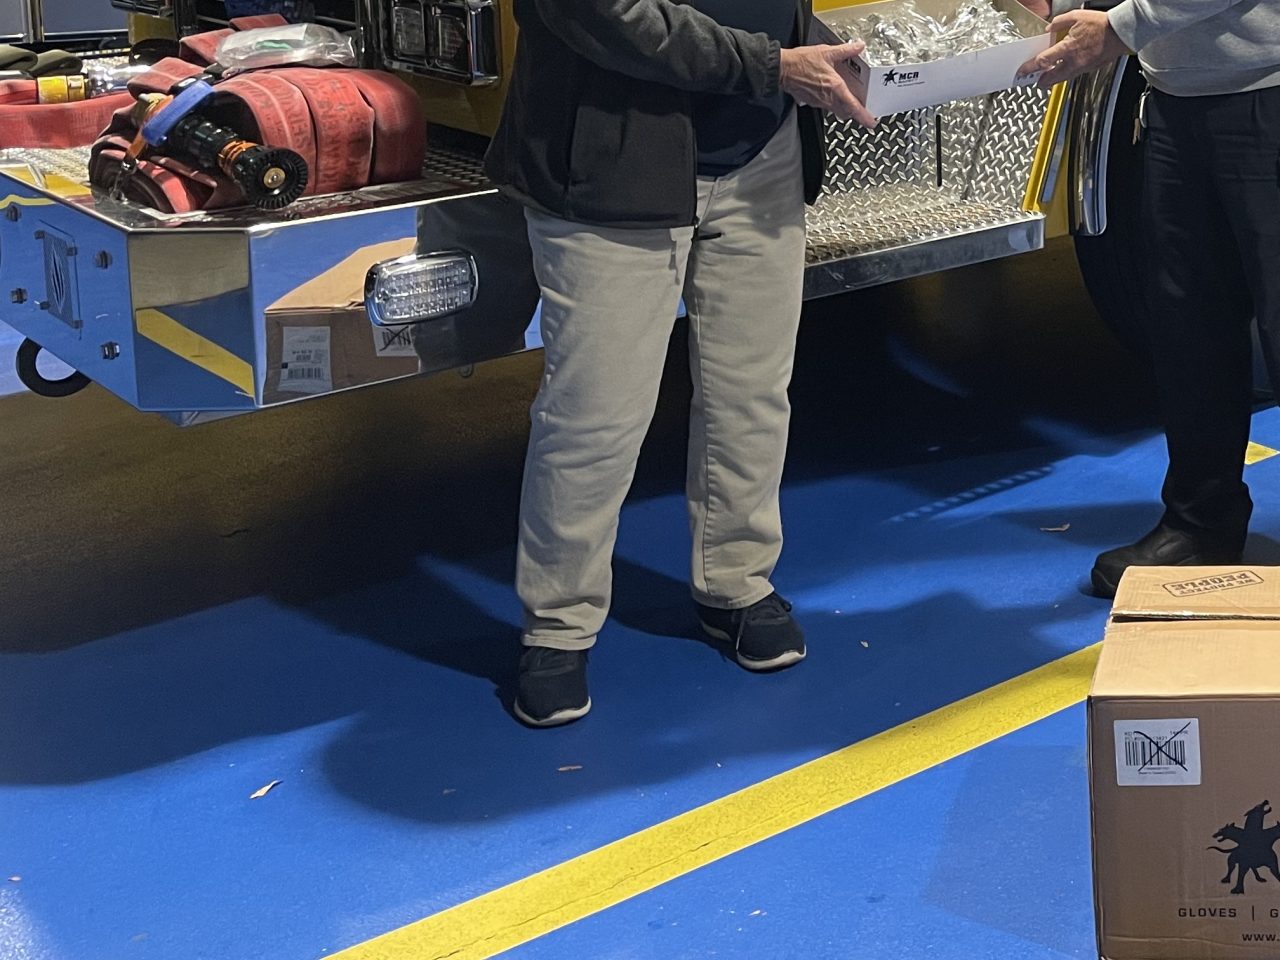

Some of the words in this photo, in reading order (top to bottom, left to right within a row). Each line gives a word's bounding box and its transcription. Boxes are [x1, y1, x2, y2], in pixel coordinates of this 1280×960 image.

[899, 71, 919, 80] MCR
[1171, 573, 1250, 592] PEOPLE
[1178, 907, 1237, 917] GLOVES
